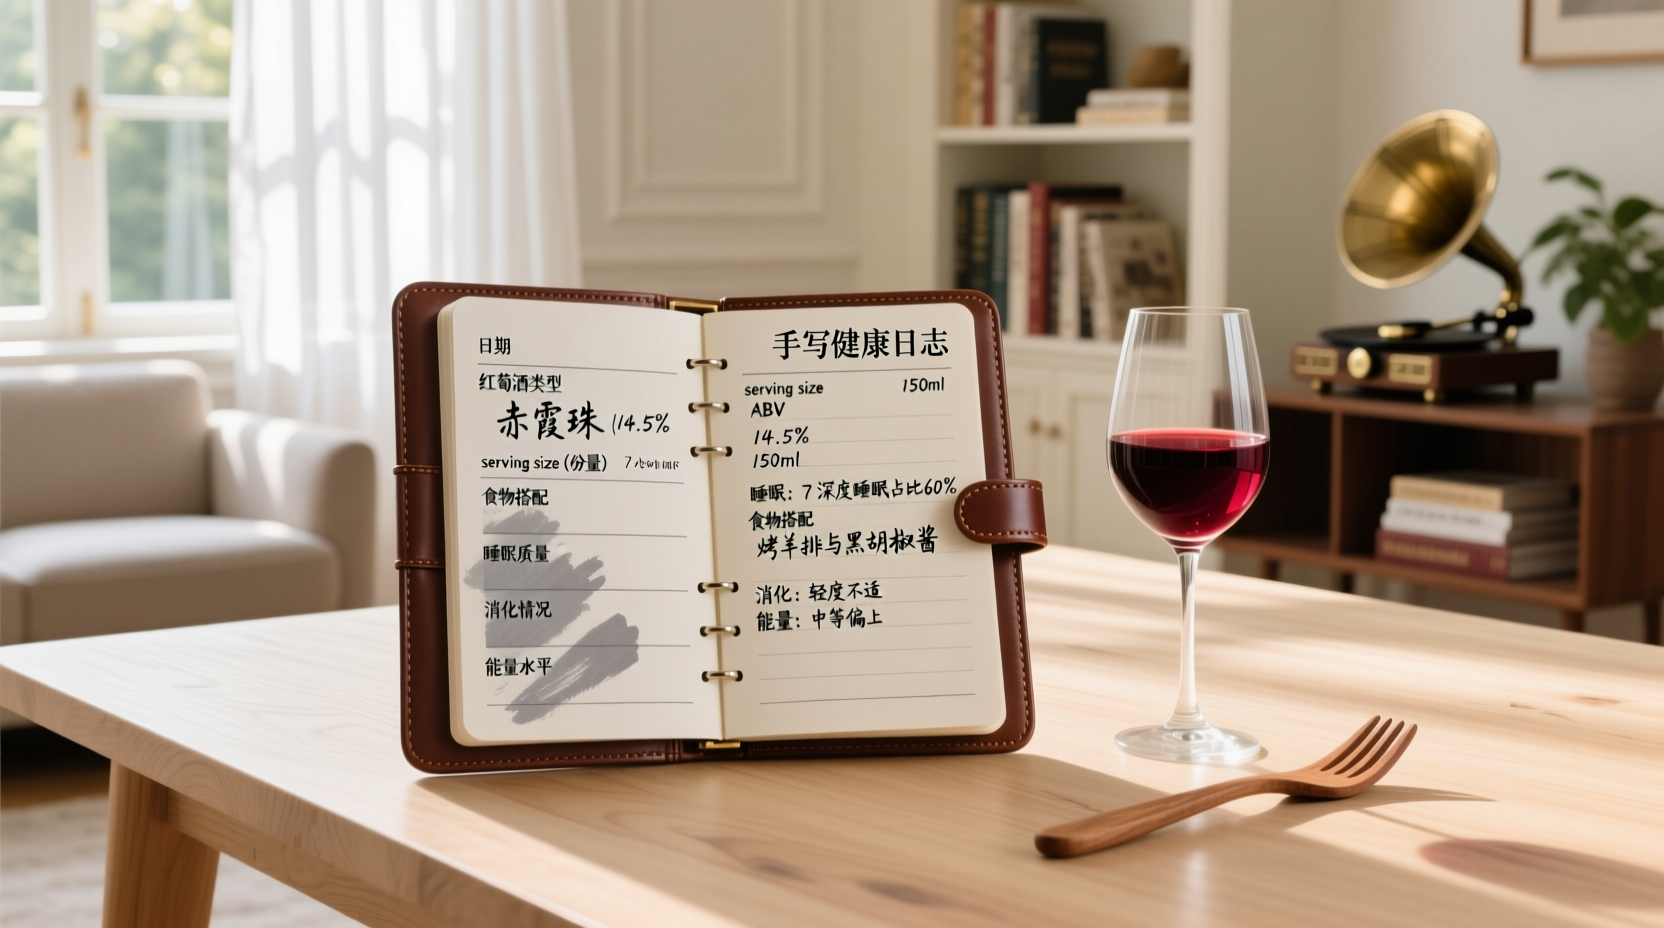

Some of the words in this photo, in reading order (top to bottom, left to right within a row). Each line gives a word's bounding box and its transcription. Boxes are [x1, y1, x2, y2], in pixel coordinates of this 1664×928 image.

[479, 336, 511, 356] 日期
[772, 327, 949, 361] 手写健康日志
[744, 381, 794, 398] serving
[798, 380, 824, 395] size
[902, 376, 945, 393] 150ml
[750, 401, 786, 418] ABV
[496, 400, 605, 441] 赤霞珠
[612, 412, 670, 436] (14.5%
[754, 425, 809, 446] 14.5%
[481, 455, 530, 473] serving
[533, 455, 560, 470] size
[753, 450, 800, 469] 150ml
[482, 486, 549, 507] 食物搭配
[748, 510, 815, 532] 食物搭配
[755, 523, 939, 561] 烤羊排与黑胡椒酱
[483, 543, 550, 564] 睡眠质量
[484, 599, 553, 620] 消化情况
[484, 656, 553, 677] 能量水平
